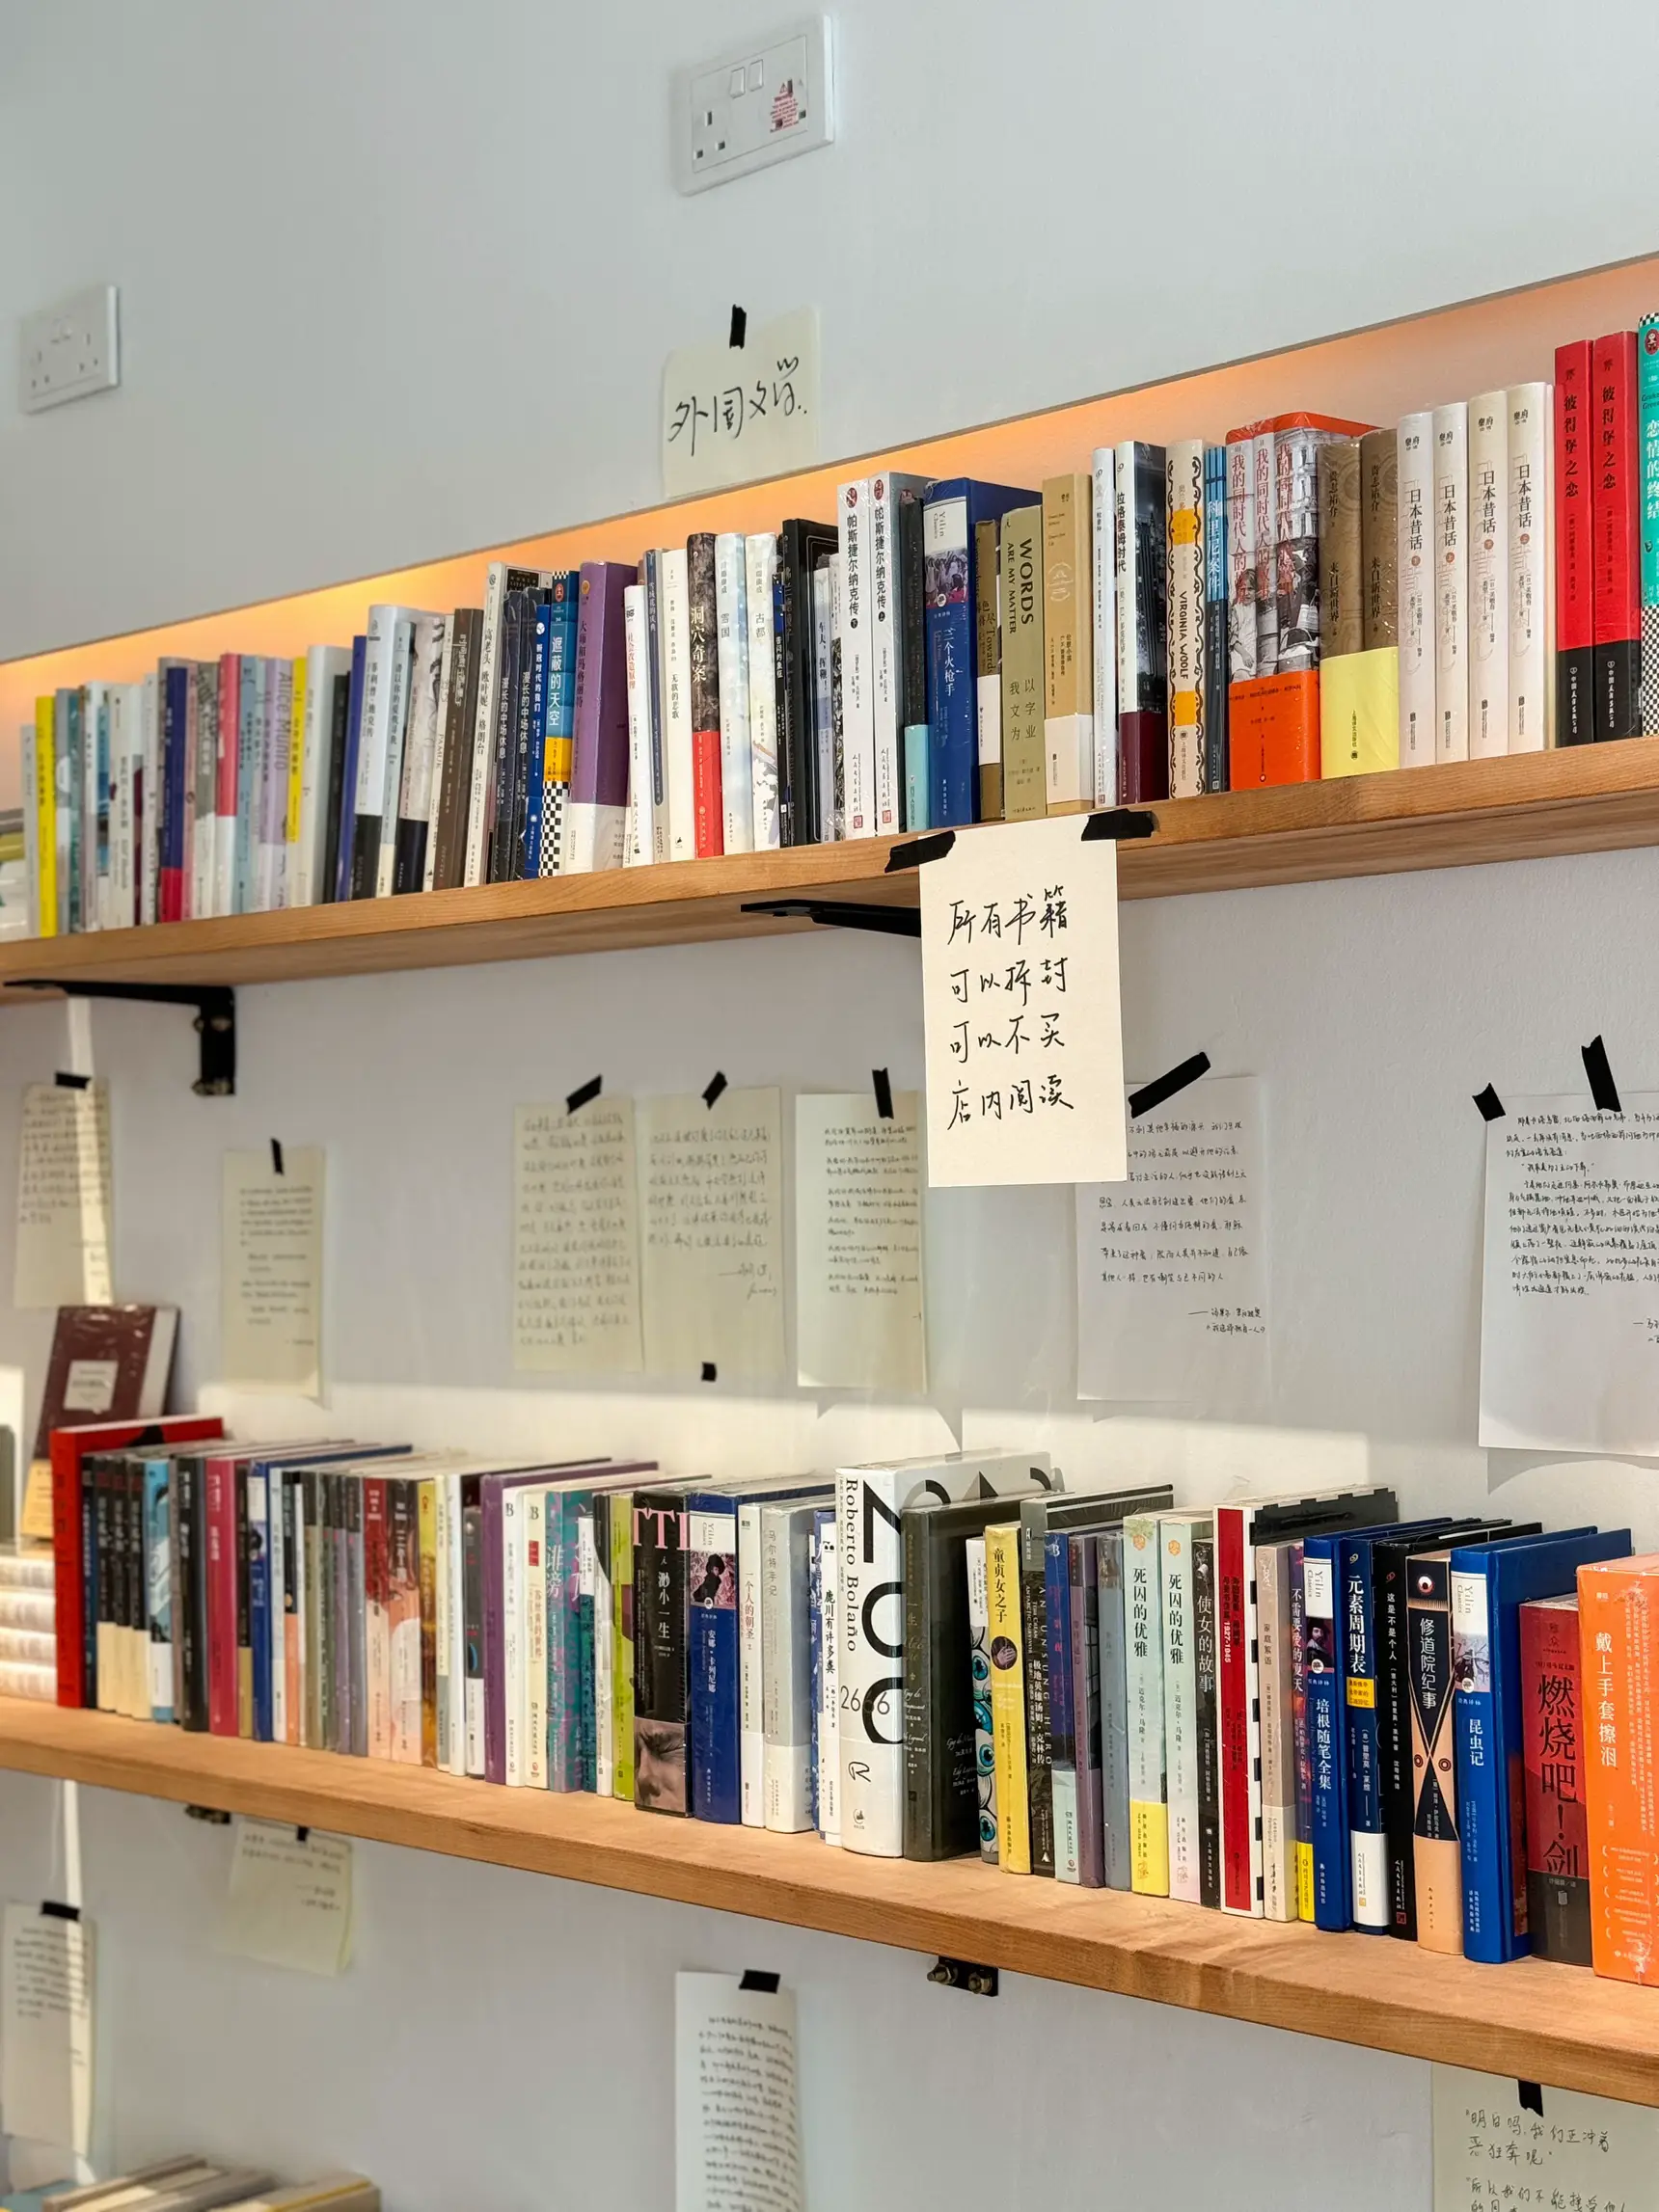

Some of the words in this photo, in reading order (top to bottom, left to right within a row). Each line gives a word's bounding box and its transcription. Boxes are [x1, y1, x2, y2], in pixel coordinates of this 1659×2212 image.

[1564, 394, 1579, 498] 彼得堡之恋
[1602, 386, 1616, 490] 彼得堡之恋
[1409, 489, 1423, 551] 日本昔话
[1444, 484, 1457, 547] 日本昔话
[1482, 471, 1496, 534] 日本昔话
[1518, 464, 1532, 528] 日本昔话
[847, 514, 859, 616] 帕斯捷尔纳克传
[874, 506, 885, 610] 帕斯捷尔纳克传
[1007, 542, 1016, 563] ARE
[1117, 492, 1127, 573] 拉格泰姆时代
[1207, 499, 1223, 594] 科里尼案件
[1008, 567, 1016, 584] MY
[1020, 537, 1034, 625] WORDS
[691, 606, 707, 683] 洞穴奇案
[721, 613, 730, 639] 雪国
[755, 613, 766, 638] 古都
[1008, 589, 1017, 634] MATTER
[1180, 590, 1188, 640] VIRGINIA
[277, 671, 292, 714] Alice
[533, 643, 544, 713] 新冠时代的我们
[549, 636, 564, 727] 遮蔽的天空
[943, 628, 957, 696] 三个火枪手
[1180, 640, 1189, 680] WOOLF
[275, 719, 292, 771] Munro
[499, 677, 510, 760] 漫长的中场休息
[519, 671, 531, 754] 漫长的中场休息
[436, 734, 445, 769] PAMUK
[947, 884, 1069, 945] 所有书籍
[949, 957, 1069, 1007] 可以拆封
[949, 1012, 1066, 1064] 可以不买
[947, 1073, 1074, 1131] 店内阅读
[845, 1477, 858, 1566] Roberto
[658, 1571, 670, 1640] 渺小一生
[745, 1572, 755, 1640] 一个人的朝圣
[846, 1575, 859, 1653] Bolaño
[993, 1548, 1008, 1624] 童贞女之子
[1039, 1586, 1047, 1609] AN
[1133, 1567, 1149, 1658] 死囚的优雅
[1315, 1570, 1324, 1599] Yilin
[1464, 1584, 1475, 1615] Yilin
[1168, 1574, 1184, 1665] 死囚的优雅
[1197, 1594, 1214, 1693] 使女的故事
[1223, 1621, 1233, 1664] 1927-1945
[1347, 1575, 1367, 1674] 元素周期表
[1387, 1592, 1398, 1660] 这是不是个人
[708, 1630, 718, 1694] 安娜·卡列尼娜
[1040, 1625, 1051, 1700] UNSUNG
[1420, 1617, 1437, 1710] 修道院纪事
[1594, 1632, 1618, 1767] 戴上手套擦泪
[1045, 1715, 1053, 1766] HERO
[1316, 1698, 1332, 1791] 培根随笔全集
[1469, 1718, 1485, 1767] 昆虫记
[1537, 1674, 1579, 1876] 燃烧吧!剑
